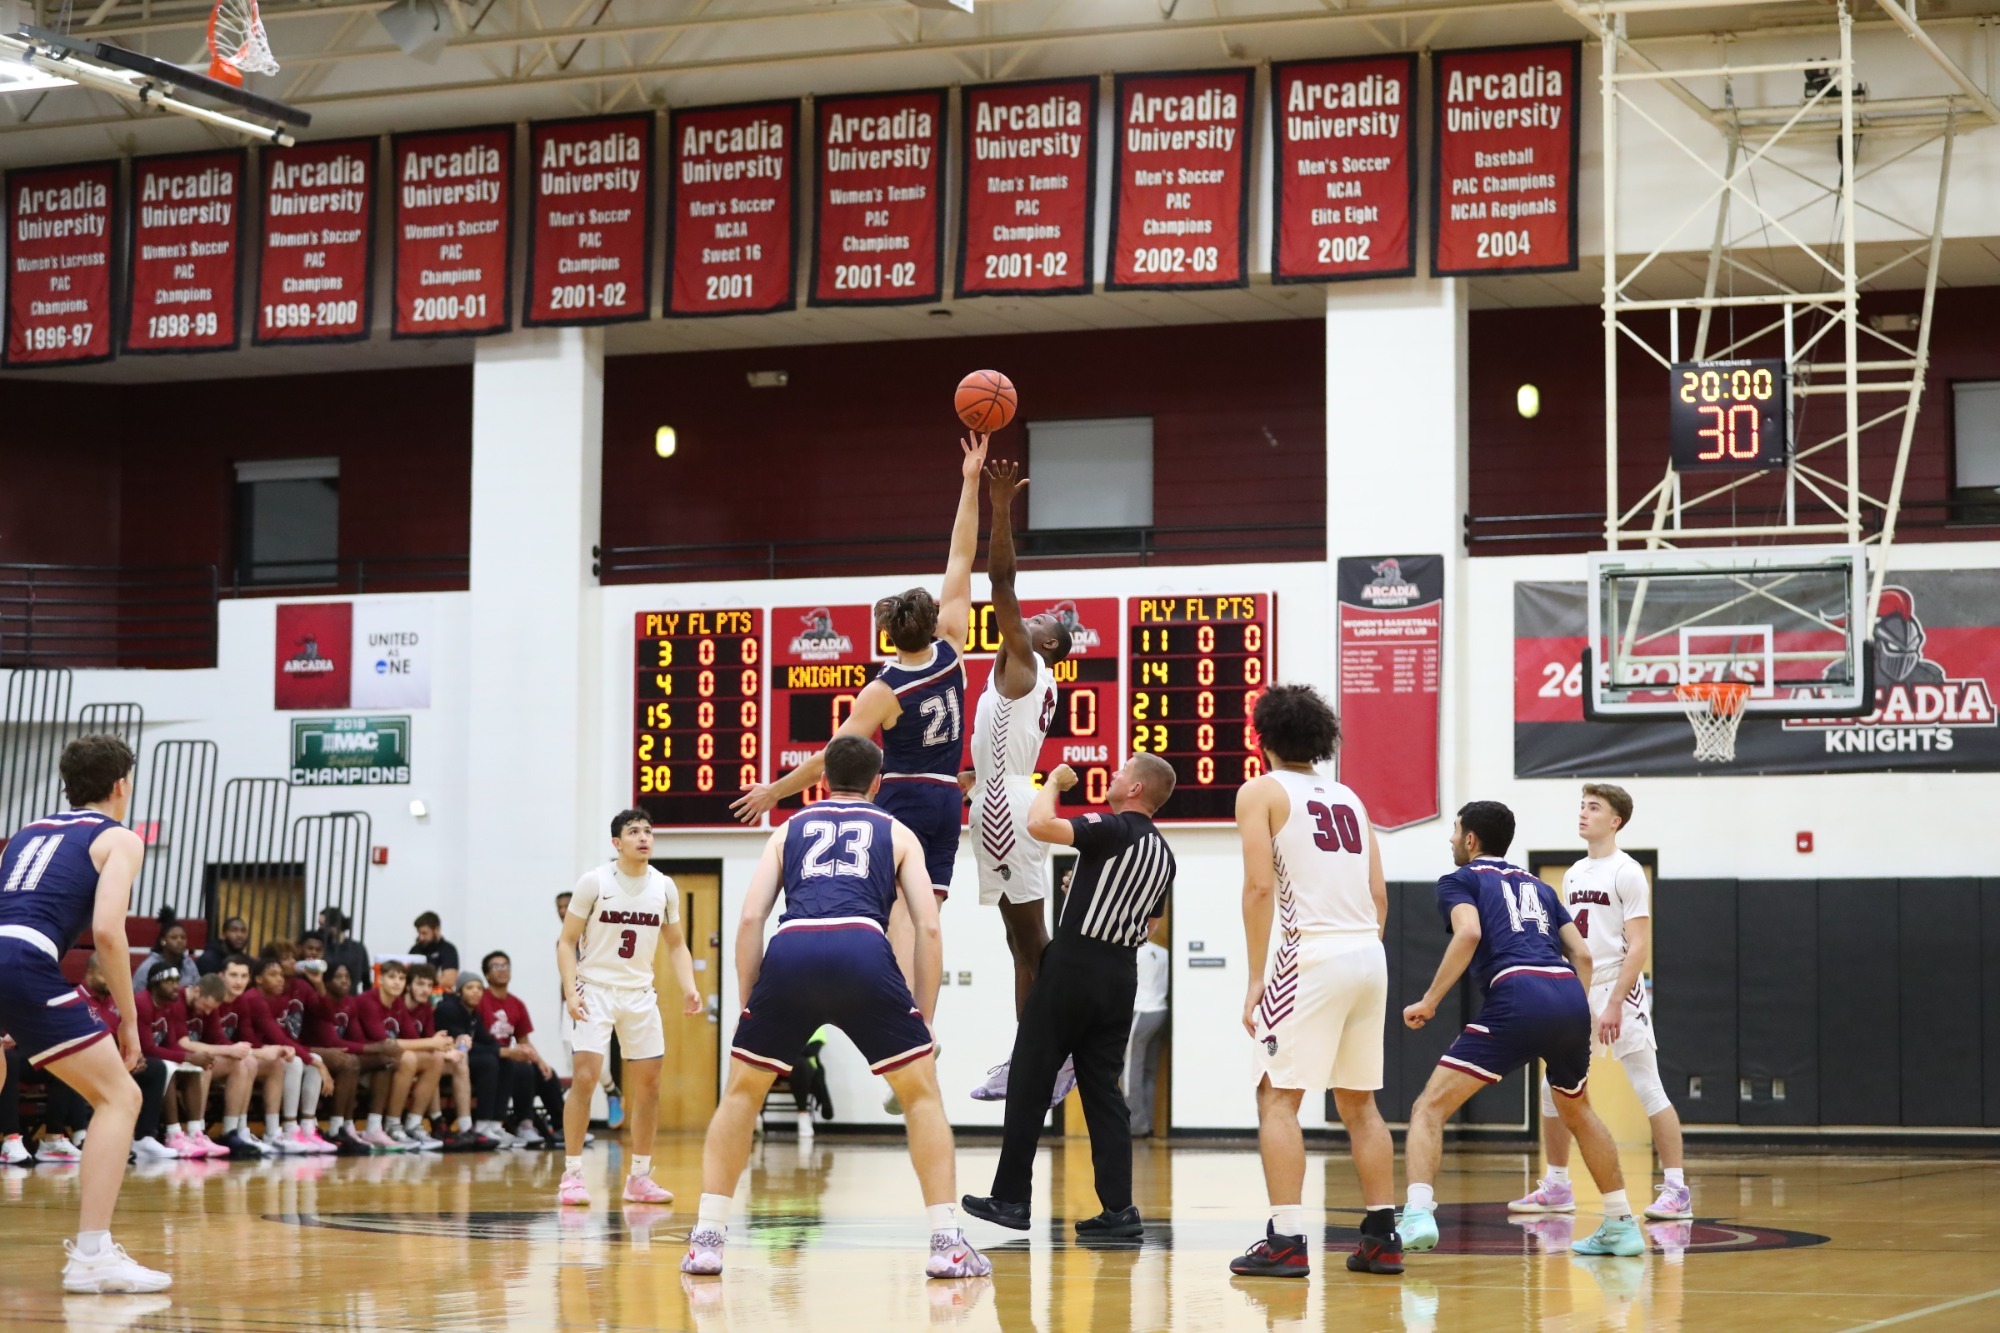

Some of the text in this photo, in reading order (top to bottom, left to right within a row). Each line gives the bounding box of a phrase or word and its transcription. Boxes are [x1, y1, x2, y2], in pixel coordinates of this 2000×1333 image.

[1288, 74, 1400, 112] Arcadia
[1447, 65, 1563, 103] Arcadia
[975, 96, 1082, 133] Arcadia
[1128, 88, 1238, 125] Arcadia
[1447, 102, 1562, 133] University
[682, 119, 784, 157] Arcadia
[828, 107, 932, 144] Arcadia
[1127, 125, 1236, 153] University
[1287, 111, 1400, 142] University
[541, 132, 641, 169] Arcadia
[827, 143, 931, 173] University
[975, 131, 1082, 161] University
[1474, 147, 1534, 169] Baseball
[271, 154, 365, 190] Arcadia
[403, 145, 500, 182] Arcadia
[682, 155, 783, 185] University
[1135, 167, 1225, 187] Men's Soccer
[1297, 155, 1391, 176] Men's Soccer
[142, 168, 233, 202] Arcadia
[403, 179, 500, 209] University
[541, 167, 640, 196] University
[829, 184, 926, 205] Women's Tennis
[987, 173, 1069, 194] Men's Tennis
[1326, 180, 1362, 199] NCAA
[1452, 173, 1556, 196] PAC Champions
[18, 181, 107, 215] Arcadia
[270, 188, 364, 217] University
[689, 197, 775, 218] Men's Soccer
[1015, 199, 1040, 217] PAC
[1165, 192, 1192, 210] PAC
[1451, 197, 1556, 221] NCAA Regionals
[18, 214, 106, 242] University
[142, 201, 231, 229] University
[404, 218, 499, 240] Women's Soccer
[549, 207, 631, 228] Men's Soccer
[864, 210, 889, 228] PAC
[1142, 217, 1212, 237] Champions
[1311, 206, 1378, 226] Elite Eight
[269, 228, 361, 247] Women's Soccer
[578, 232, 602, 249] PAC
[715, 222, 748, 239] NCAA
[842, 234, 910, 254] Champions
[992, 224, 1061, 243] Champions
[142, 240, 230, 260] Women's Soccer
[440, 244, 463, 261] PAC
[702, 243, 762, 264] Sweet 16
[1317, 235, 1371, 264] 2002
[1476, 230, 1531, 260] 2004
[17, 251, 105, 272] Women's Lacrosse
[174, 264, 195, 280] PAC
[304, 252, 326, 268] PAC
[558, 255, 620, 274] Champions
[984, 251, 1068, 280] 2001-02
[1133, 246, 1219, 274] 2002-03
[50, 276, 71, 292] PAC
[282, 276, 343, 294] Champions
[420, 267, 482, 287] Champions
[706, 273, 753, 300] 2001
[834, 262, 916, 290] 2001-02
[30, 298, 88, 317] Champions
[155, 287, 213, 305] Champions
[412, 293, 487, 322] 2000-01
[550, 282, 627, 310] 2001-02
[148, 312, 218, 339] 1998-99
[264, 300, 358, 328] 1999-2000
[25, 323, 93, 351] 1996-97
[1680, 368, 1773, 404] 20:00
[1697, 404, 1759, 460] 30
[1361, 583, 1420, 599] ARCADIA
[646, 611, 752, 636] PLY FL PTS
[1140, 597, 1255, 622] PLY FL PTS
[369, 632, 419, 646] UNITED
[658, 637, 757, 667] 3 0 0
[790, 637, 852, 652] ARCADIA
[1142, 624, 1261, 653] 11 0 0
[283, 659, 335, 672] ARCADIA
[388, 649, 399, 657] AS
[656, 669, 757, 697] 4 0 0
[788, 664, 866, 688] KNIGHTS
[1142, 657, 1261, 686] 14 0 0
[1538, 662, 1583, 698] 26
[647, 700, 757, 729] 15 0 0
[920, 686, 961, 747] 21
[1070, 689, 1096, 736] 0
[1133, 692, 1168, 720] 21
[1198, 691, 1214, 718] 0
[638, 732, 757, 762] 21 0 0
[1133, 725, 1168, 752] 23
[1197, 724, 1214, 751] 0
[1826, 728, 1954, 752] KNIGHTS
[780, 750, 821, 767] FOU
[1063, 745, 1108, 762] FOULS
[292, 766, 410, 784] CHAMPIONS
[640, 765, 671, 793] 30
[697, 764, 713, 792] 0
[1086, 767, 1108, 804] 0
[1306, 800, 1363, 855] 30
[4, 834, 65, 891] 11
[801, 820, 874, 879] 23
[599, 910, 660, 927] ARCADIA
[1500, 881, 1549, 935] 14
[618, 929, 637, 959] 3
